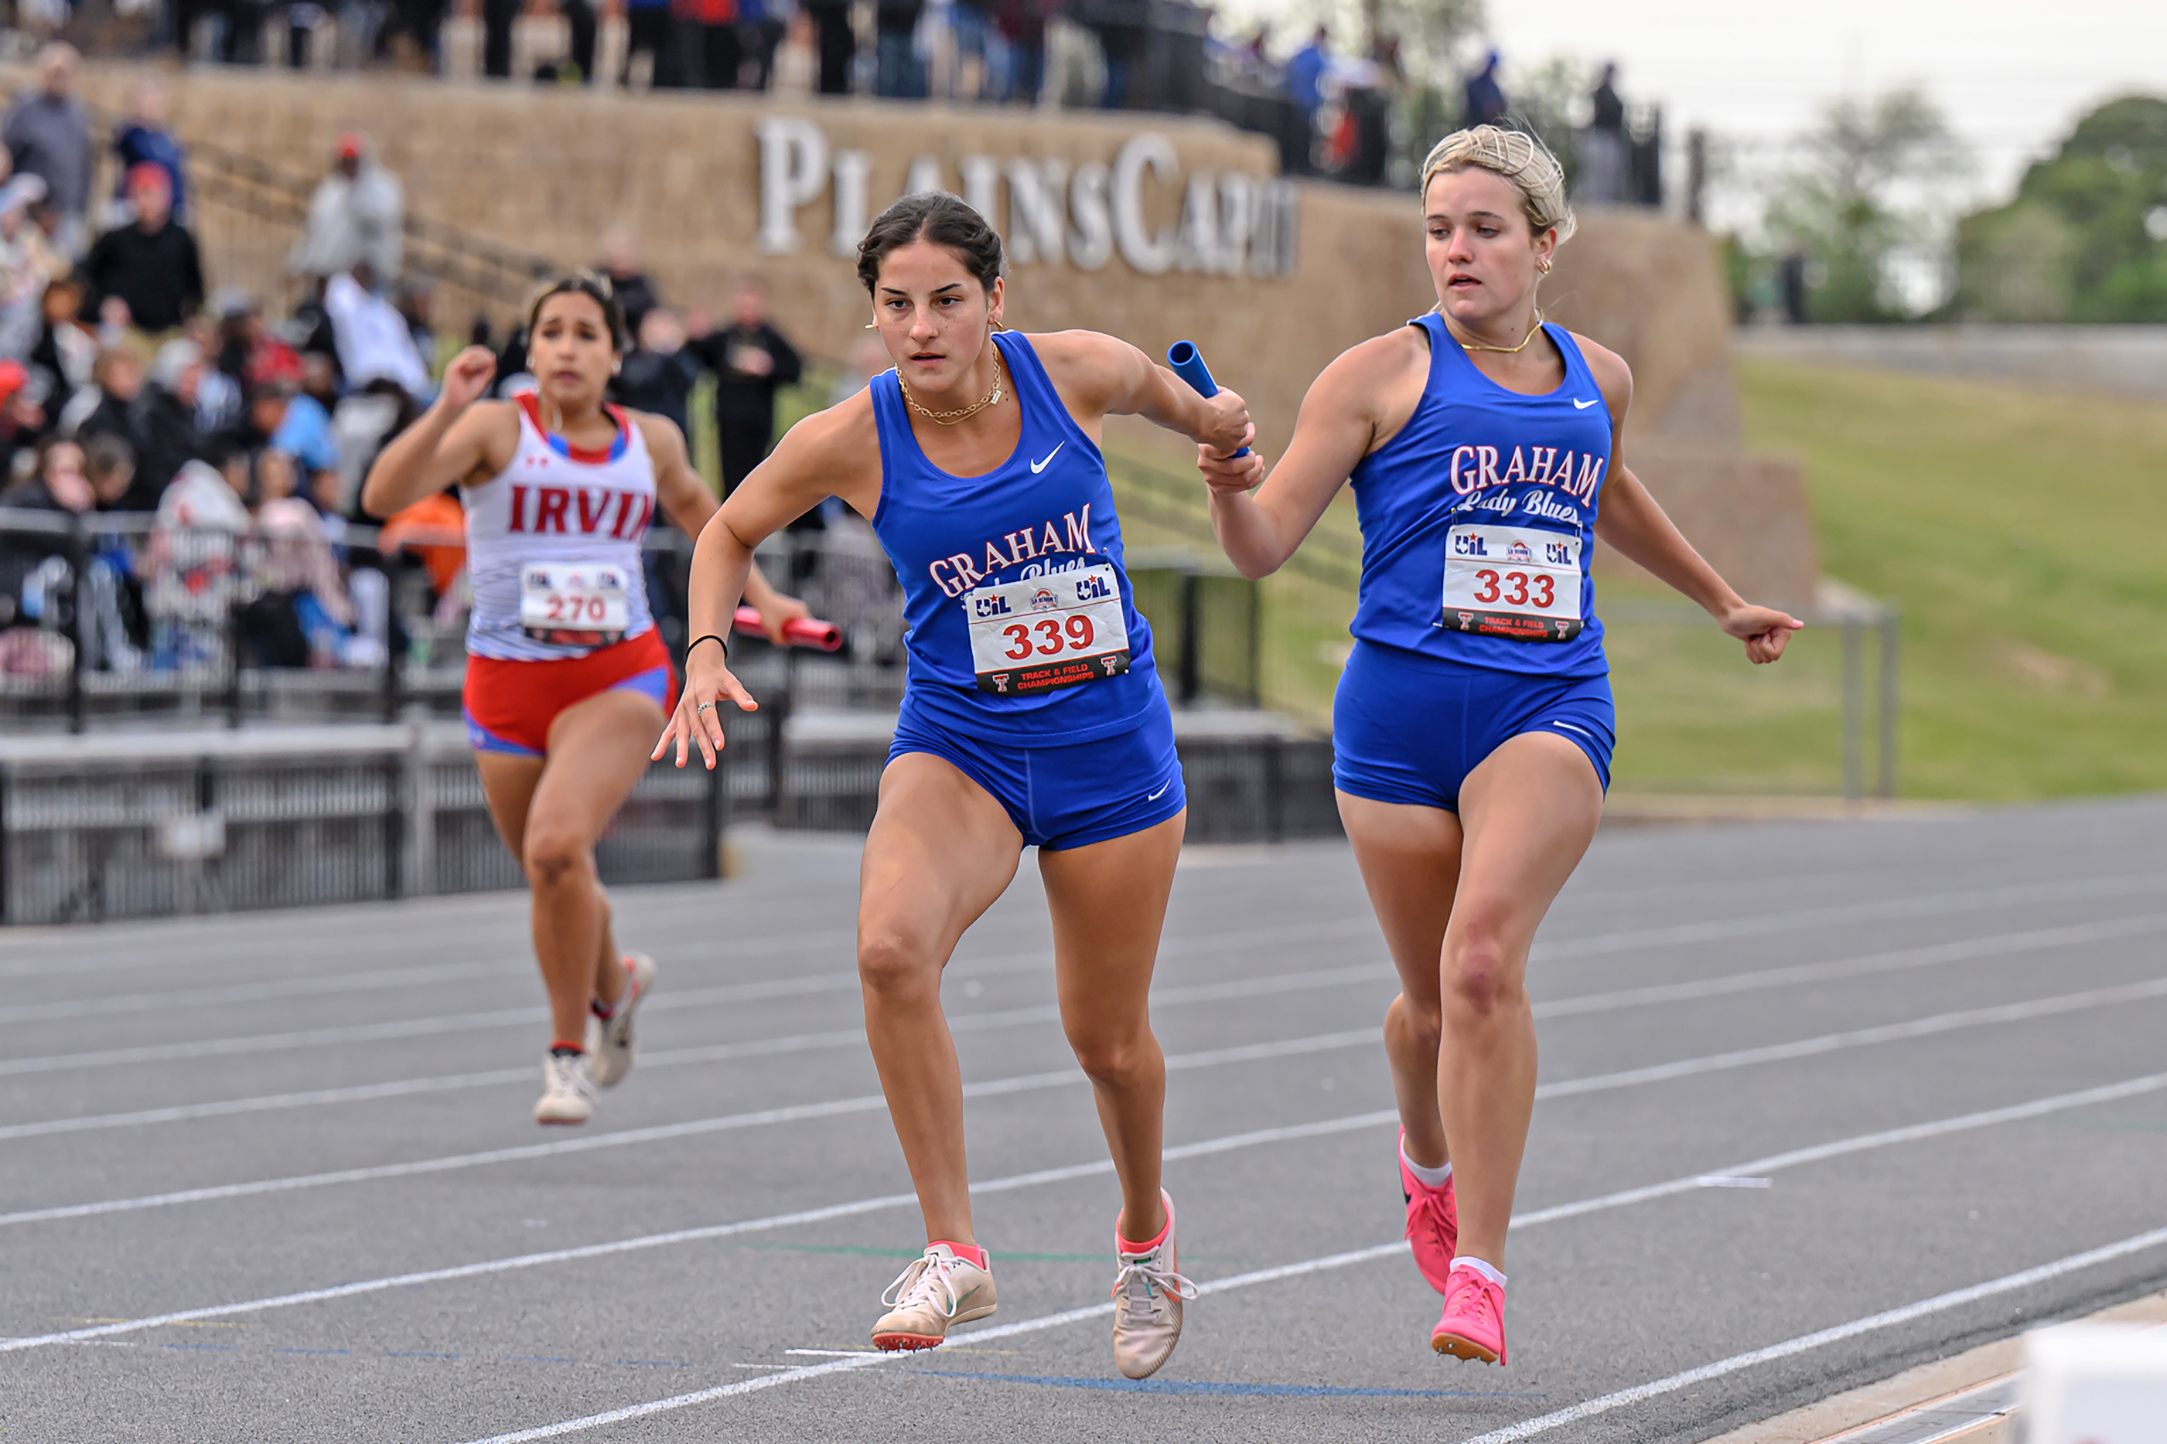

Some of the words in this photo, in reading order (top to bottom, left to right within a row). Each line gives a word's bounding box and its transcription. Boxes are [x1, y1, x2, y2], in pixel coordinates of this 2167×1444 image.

[1450, 445, 1603, 508] GRAHAM
[1457, 488, 1517, 517] Lady
[1522, 490, 1578, 524] Blues
[929, 502, 1096, 598] GRAHAM
[1474, 569, 1555, 608] 333
[546, 593, 606, 622] 270
[1484, 616, 1512, 627] TRACK
[1514, 618, 1521, 627] &
[1522, 619, 1545, 629] FIELD
[1003, 614, 1095, 660] 339
[1479, 624, 1548, 638] CHAMPIONSHIPS
[1017, 671, 1094, 690] CHAMPIONSHIPS
[1021, 669, 1051, 681] TRACK
[1053, 667, 1061, 676] &
[1062, 663, 1088, 674] FIELD
